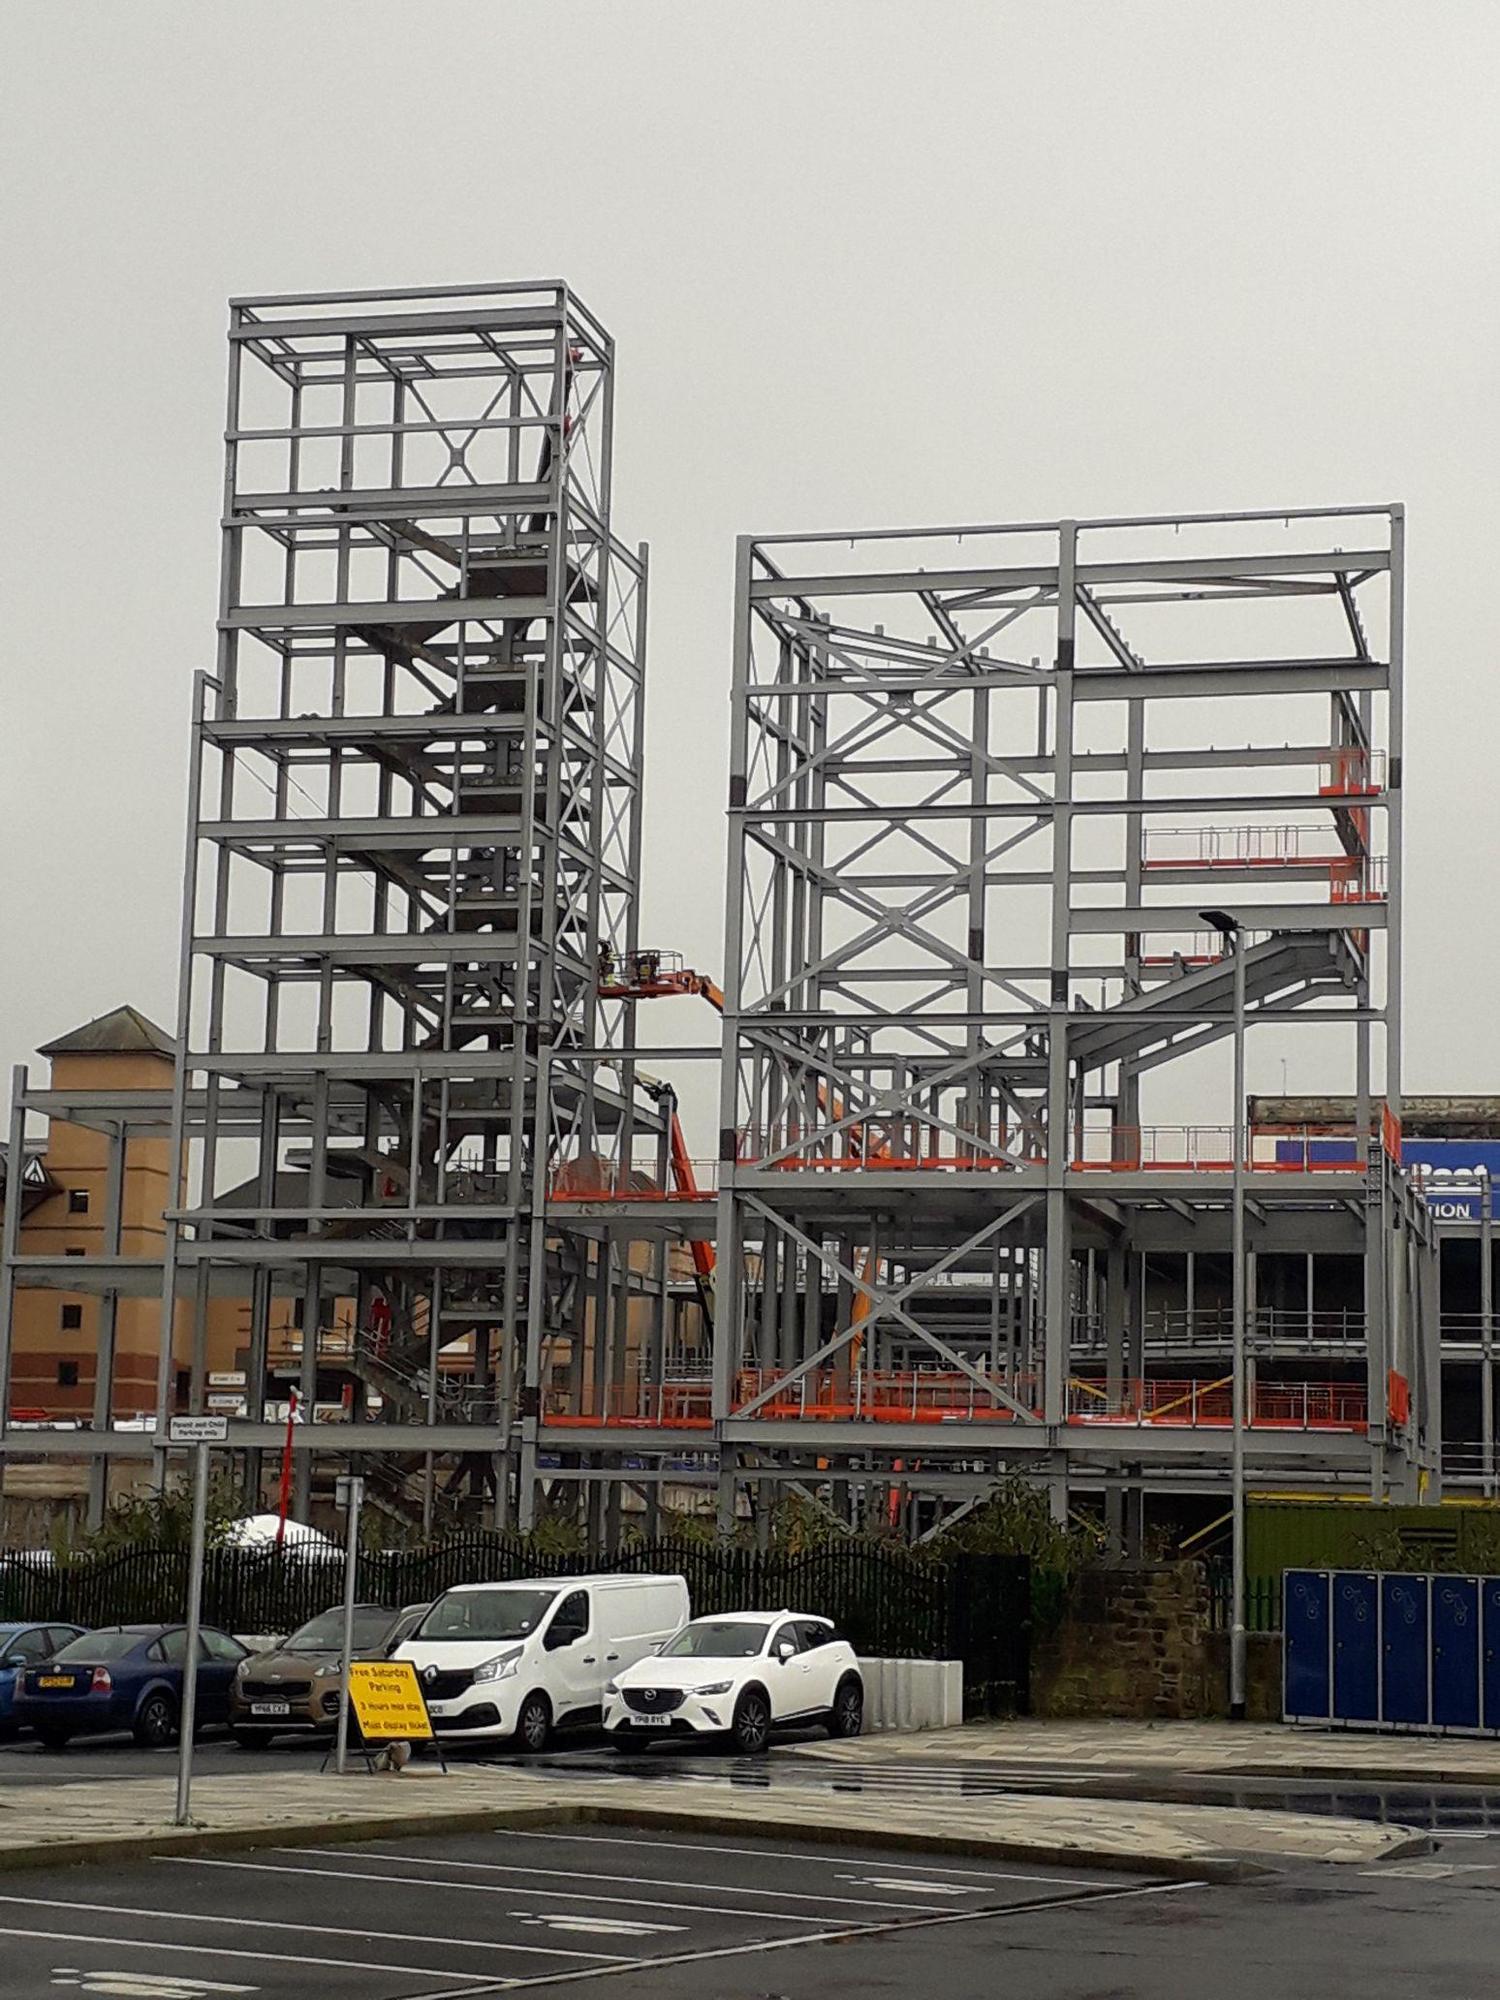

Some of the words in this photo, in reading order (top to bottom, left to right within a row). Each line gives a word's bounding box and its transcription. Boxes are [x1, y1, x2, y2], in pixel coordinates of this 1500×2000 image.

[208, 1420, 224, 1428] Child
[178, 1429, 203, 1437] Parking
[204, 1429, 217, 1437] only
[350, 1668, 369, 1677] Free
[371, 1666, 409, 1679] Saturday
[368, 1681, 402, 1694] Parking
[406, 1702, 421, 1713] stay
[362, 1720, 382, 1730] Must
[383, 1720, 407, 1732] display
